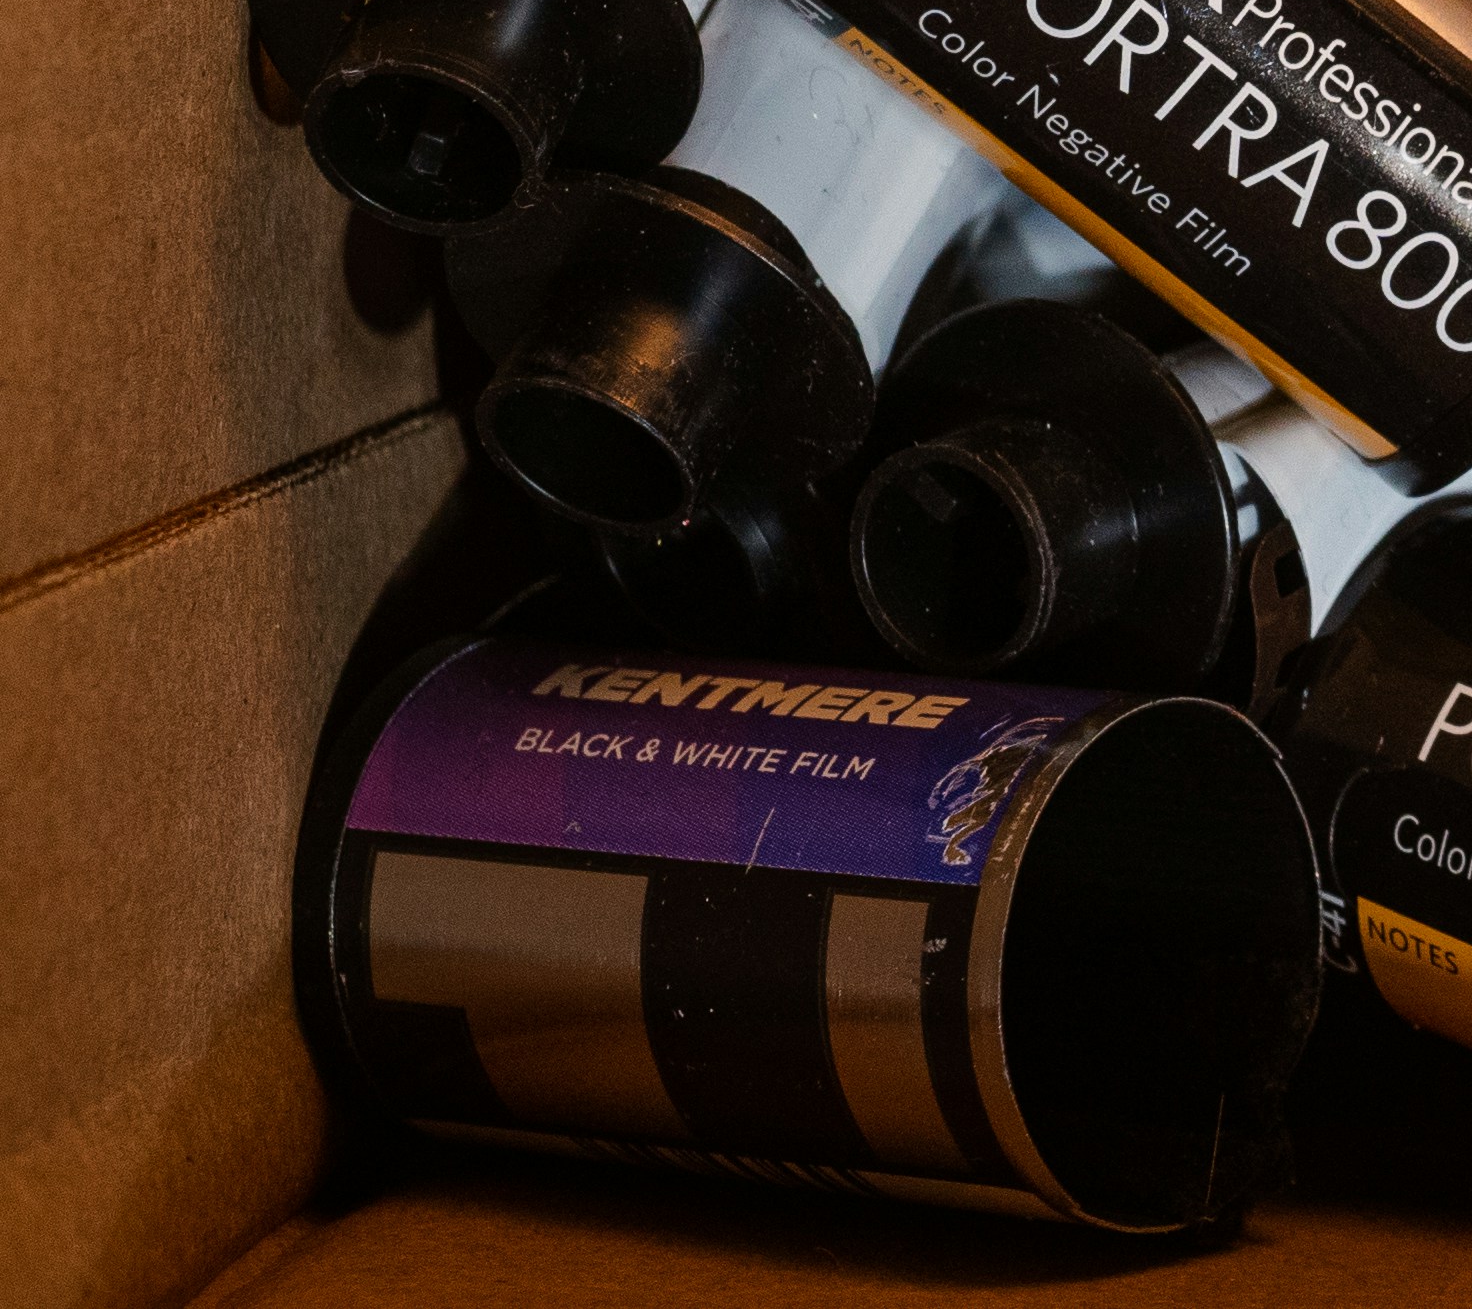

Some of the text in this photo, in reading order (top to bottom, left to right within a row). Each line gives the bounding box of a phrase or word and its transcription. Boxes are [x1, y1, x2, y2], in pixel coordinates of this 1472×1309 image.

[847, 37, 948, 116] NOTES
[915, 6, 1253, 279] Color Negative Film
[533, 662, 971, 732] KENTMERE
[513, 727, 877, 781] BLACK & WHITE FILM
[1366, 913, 1461, 980] NOTES
